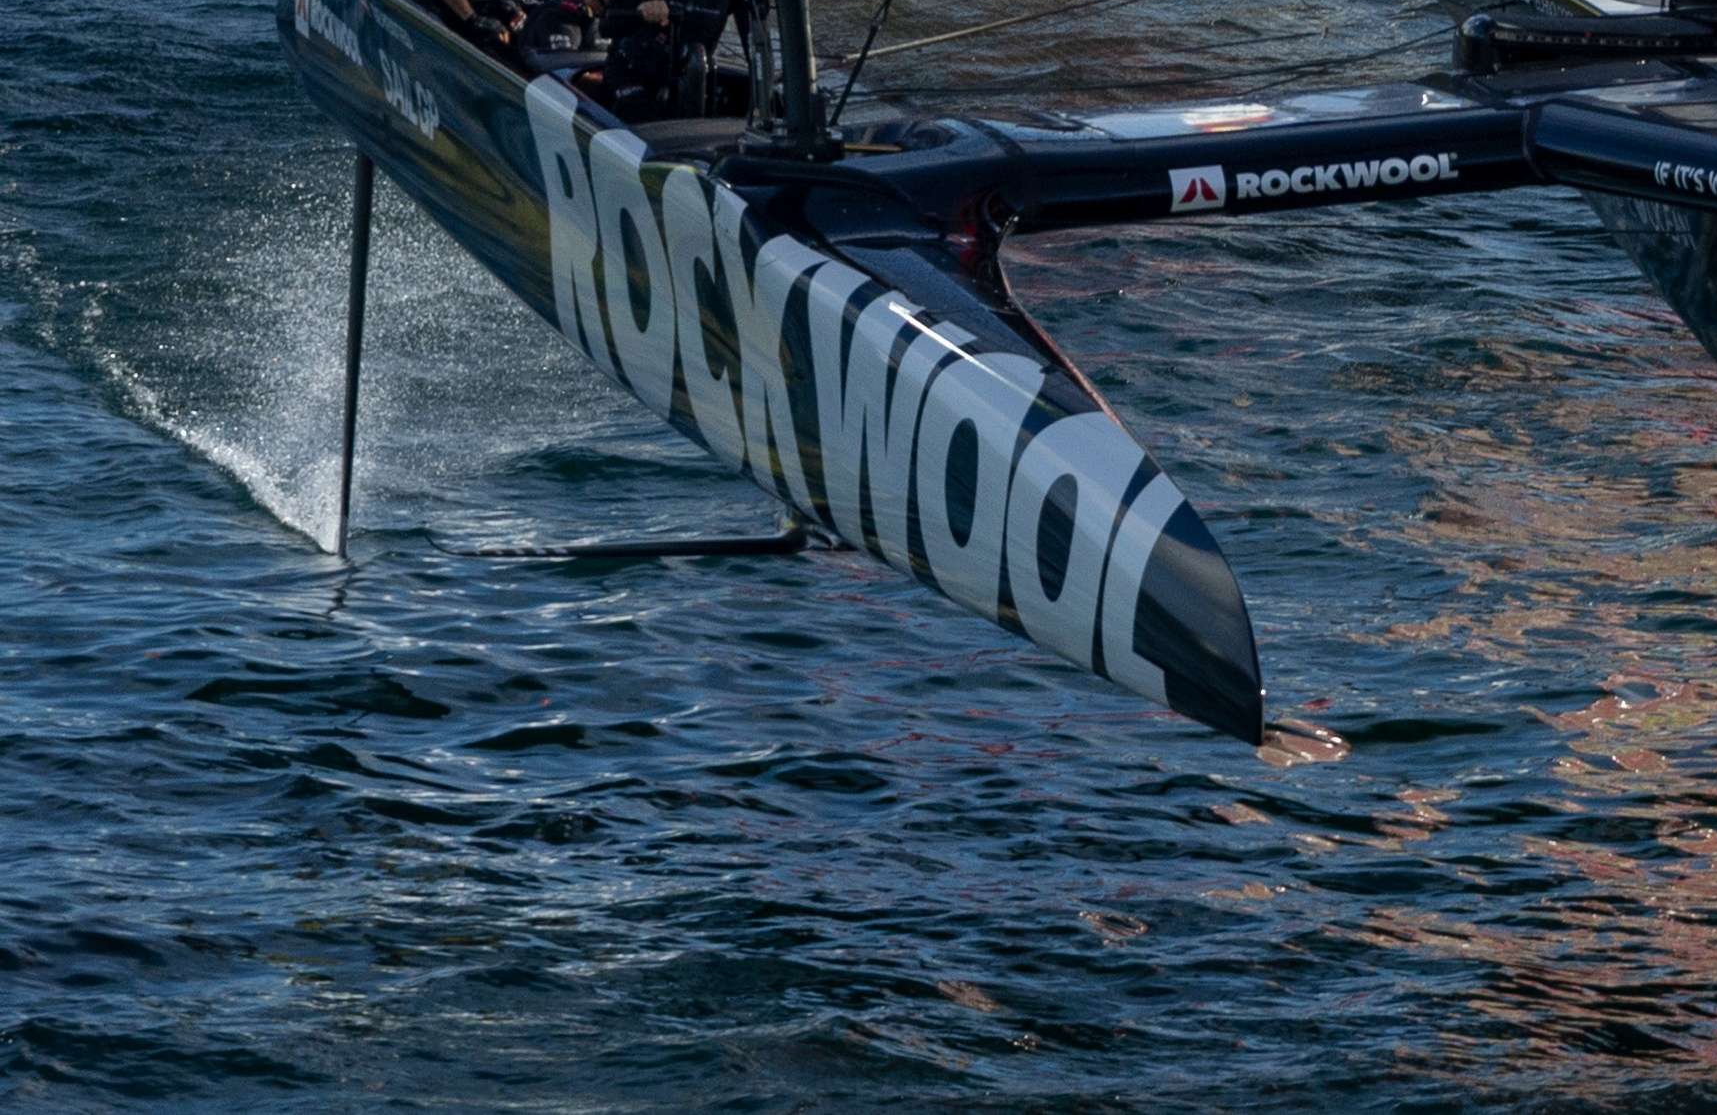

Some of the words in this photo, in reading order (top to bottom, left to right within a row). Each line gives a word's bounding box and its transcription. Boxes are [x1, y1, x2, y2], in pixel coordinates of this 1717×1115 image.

[1236, 153, 1458, 200] ROCKWOOL
[1654, 160, 1671, 185] IF
[1674, 164, 1704, 193] IT'S
[525, 73, 1187, 708] ROCKWOOL
